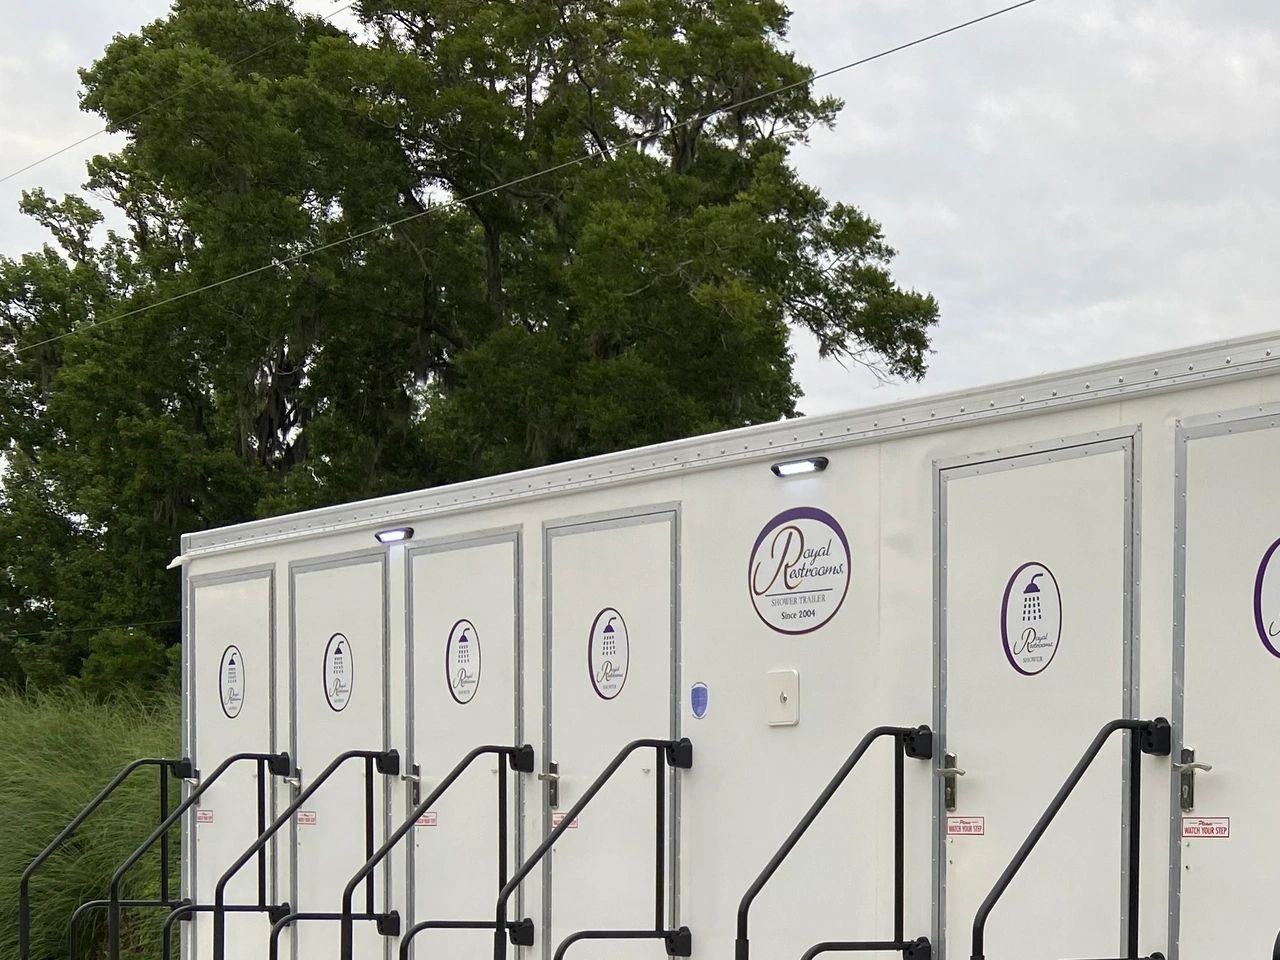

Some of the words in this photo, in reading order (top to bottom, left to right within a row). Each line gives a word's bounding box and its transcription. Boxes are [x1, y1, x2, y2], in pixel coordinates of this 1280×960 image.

[771, 597, 798, 607] SHOWER
[800, 594, 826, 604] TRAILER
[781, 611, 797, 620] Since
[799, 609, 816, 618] 2004
